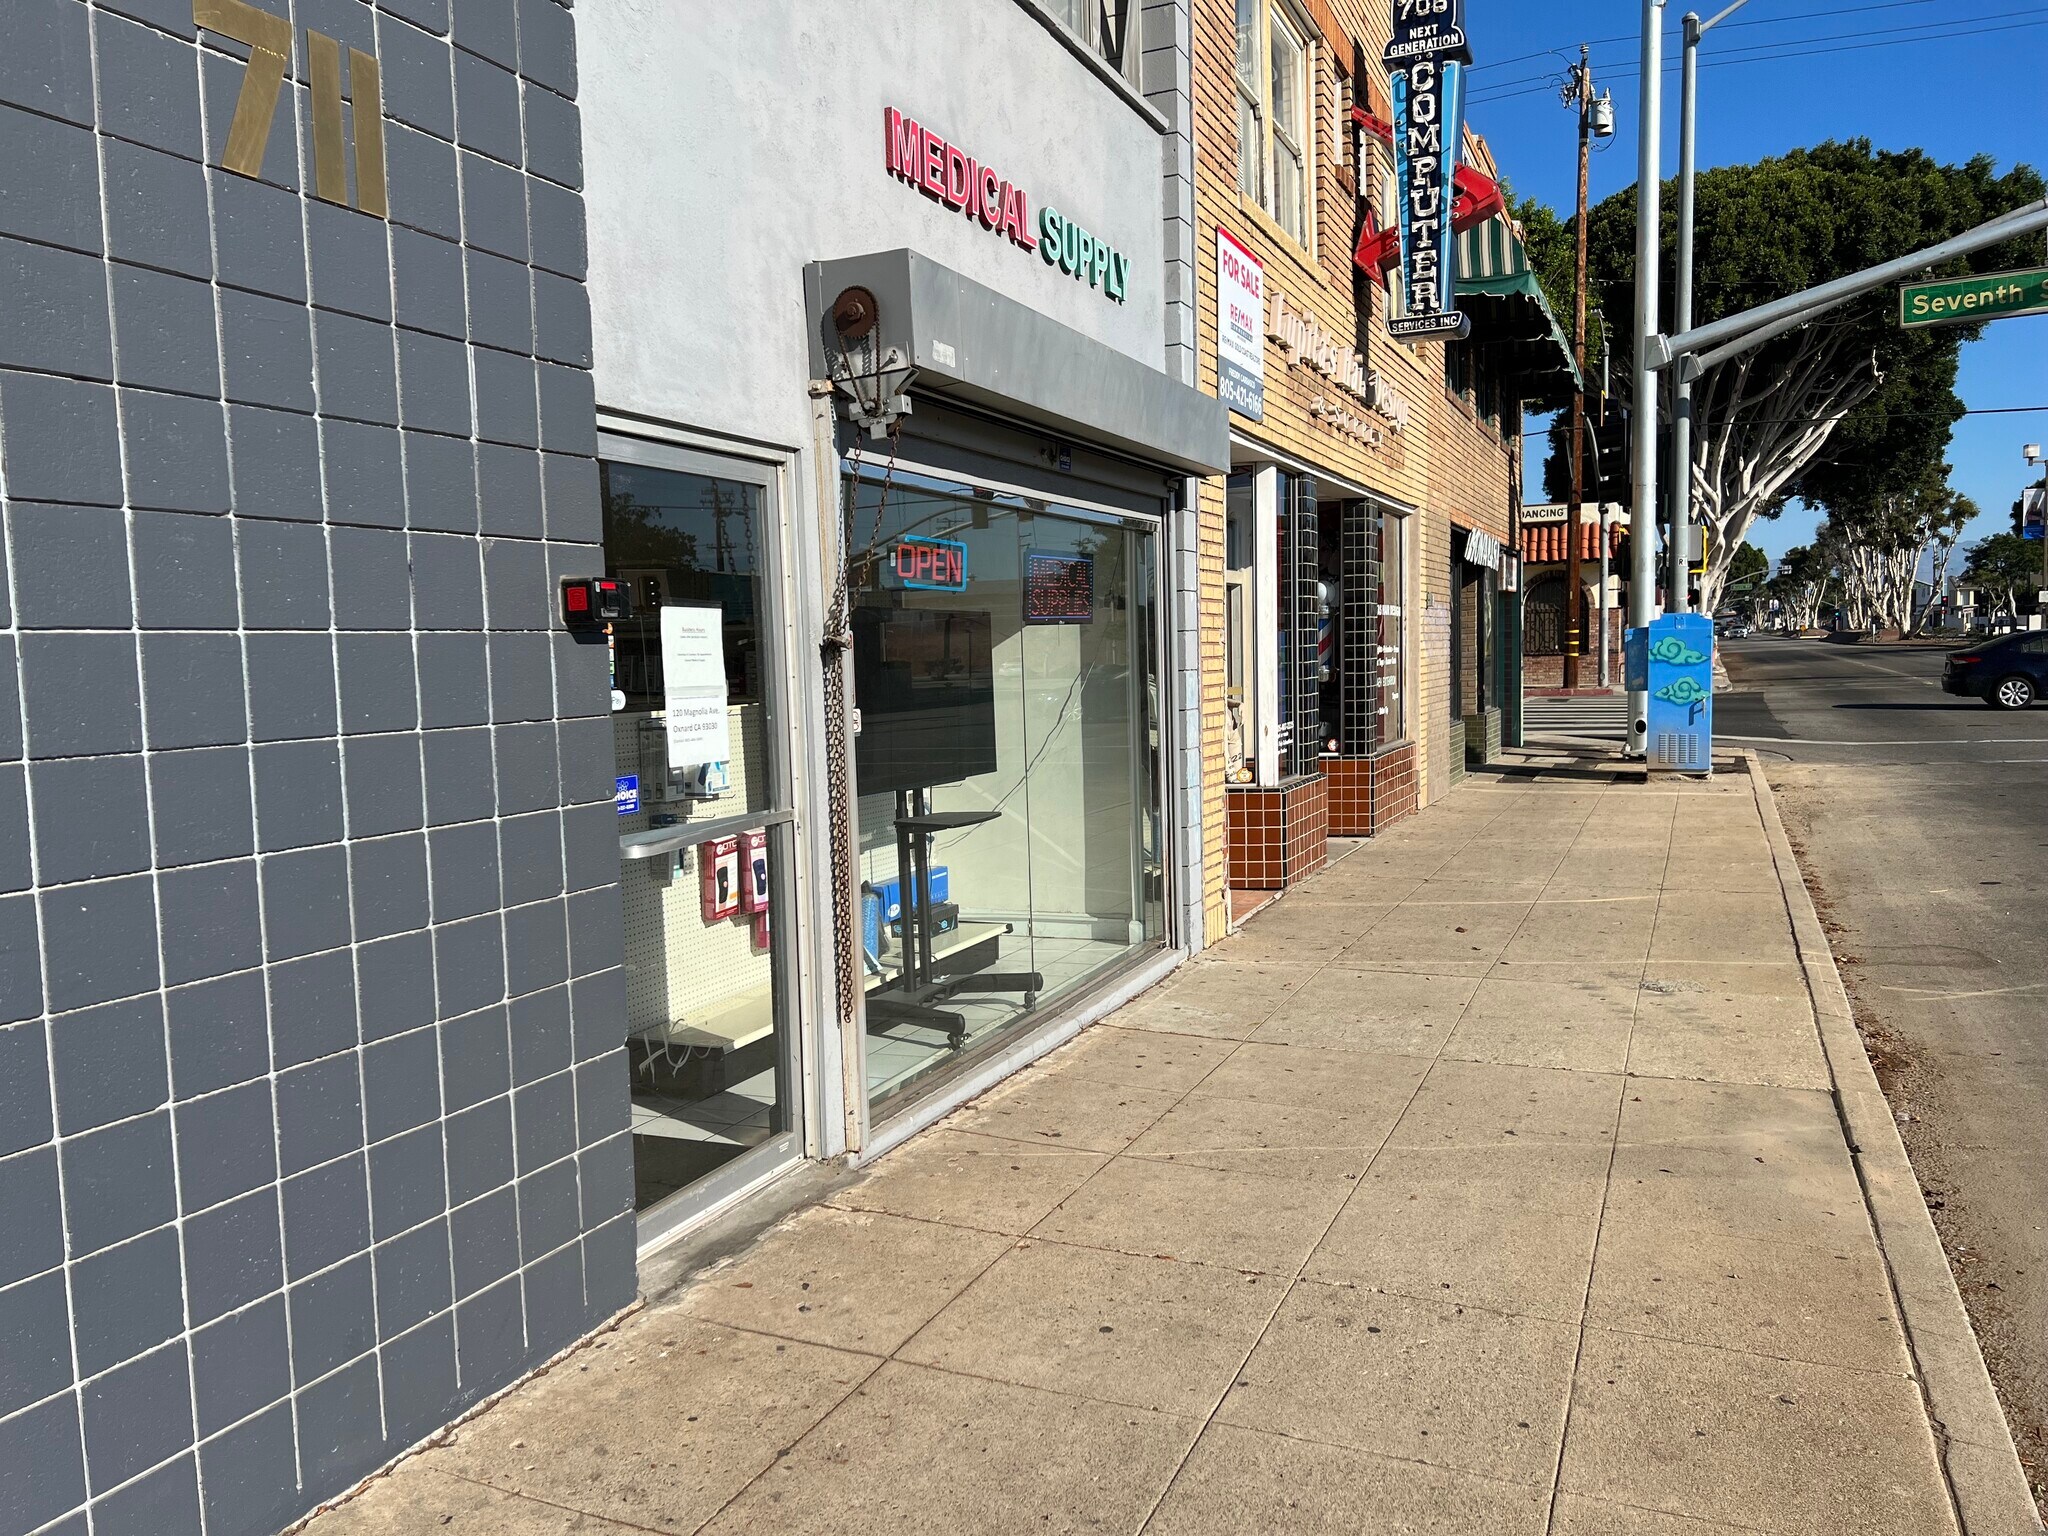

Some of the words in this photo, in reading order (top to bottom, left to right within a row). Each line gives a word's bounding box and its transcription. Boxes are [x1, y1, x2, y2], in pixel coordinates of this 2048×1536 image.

[1390, 33, 1459, 56] GENERATION
[1409, 24, 1439, 40] NEXT
[192, 0, 390, 219] 711
[1407, 61, 1441, 310] COMPUTER
[884, 106, 1037, 252] MEDICAL
[1039, 206, 1131, 303] SUPPLY
[1223, 249, 1239, 284] FOR
[1240, 264, 1260, 299] SALE
[1912, 284, 2024, 315] Seventh
[1230, 303, 1253, 333] RE/MAX
[1392, 318, 1436, 332] SERVICES
[1440, 316, 1457, 327] INC
[1521, 508, 1564, 519] ANCING
[897, 543, 962, 583] OPEN
[1033, 559, 1089, 587] MEDICAL
[1031, 589, 1090, 615] SUPPLIES
